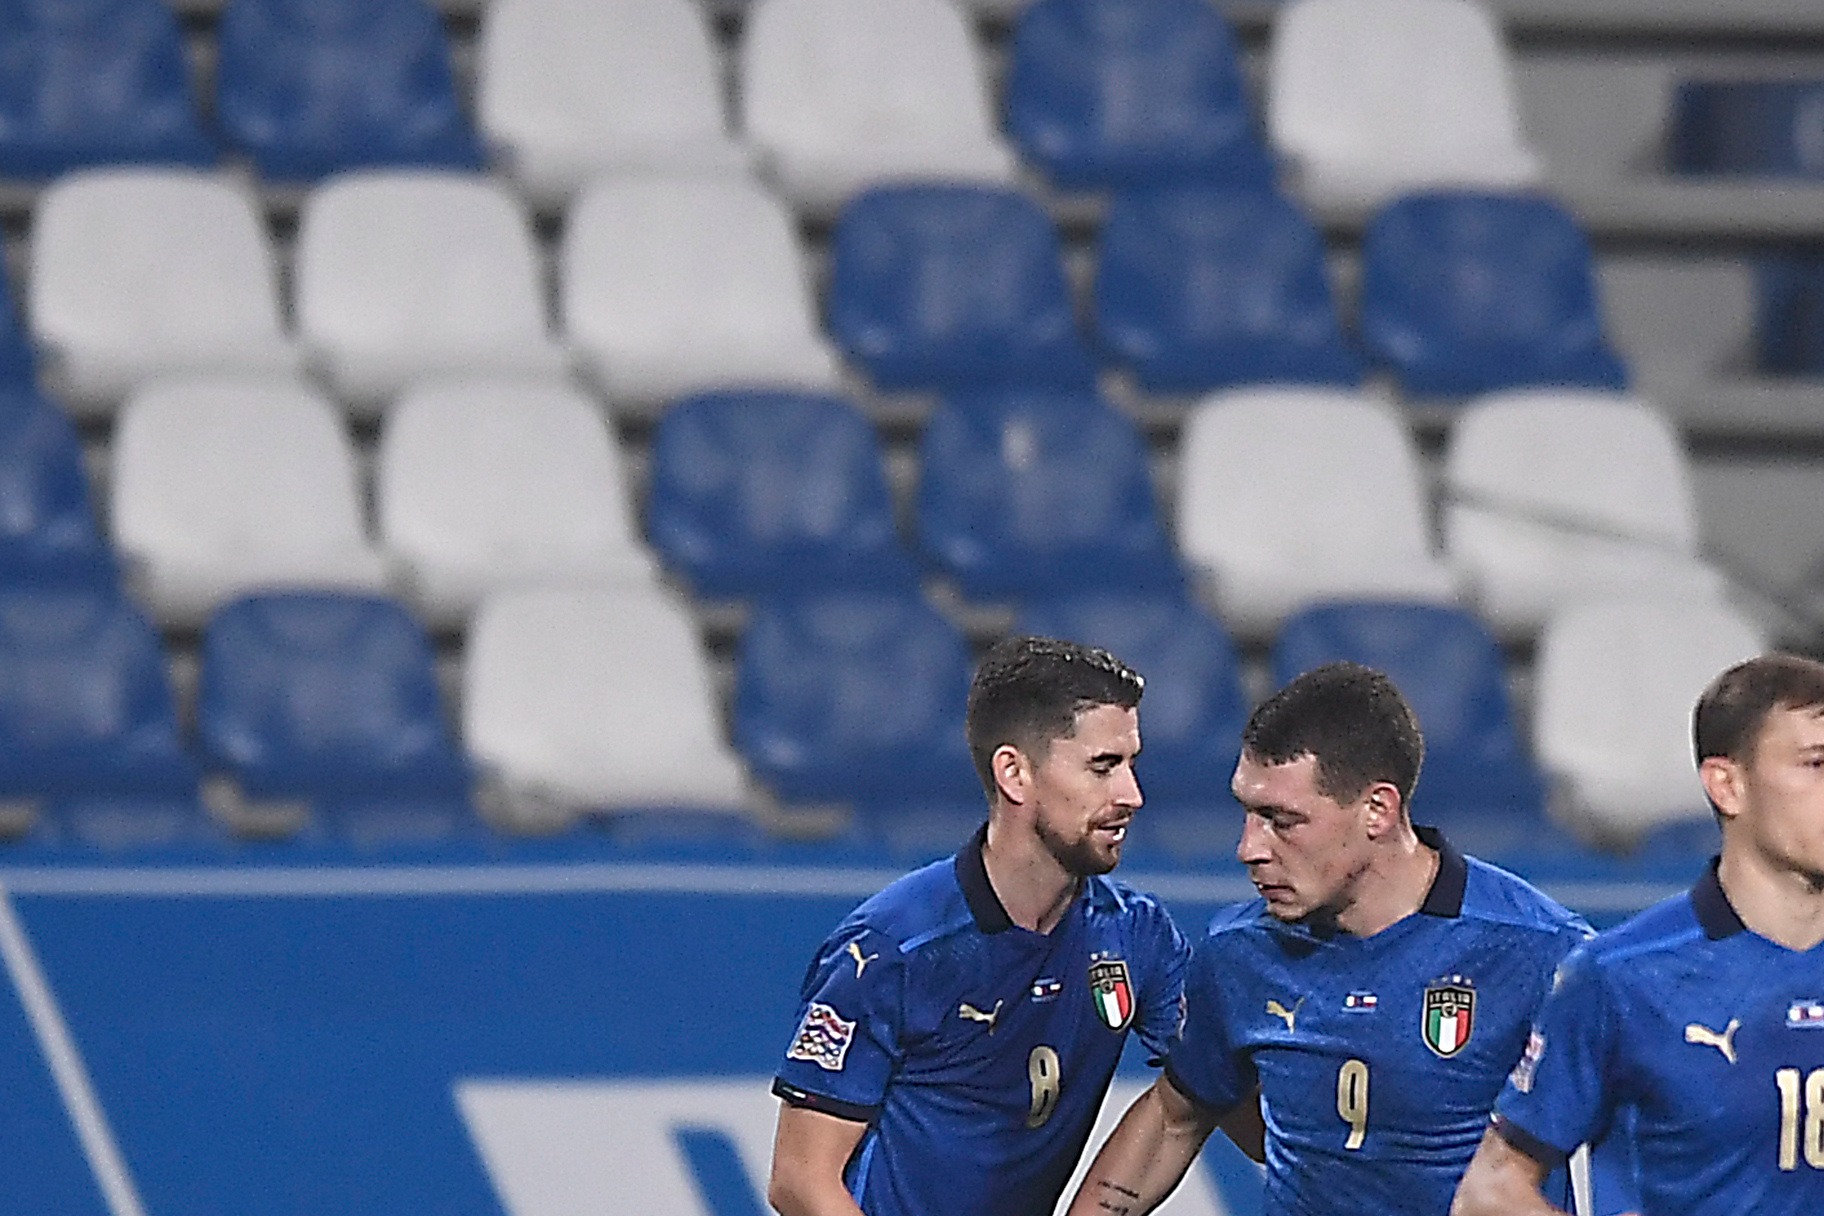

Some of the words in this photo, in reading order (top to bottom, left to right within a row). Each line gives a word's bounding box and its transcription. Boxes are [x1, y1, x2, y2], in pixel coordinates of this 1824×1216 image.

[1428, 991, 1471, 1003] ITALIA
[1028, 1045, 1061, 1129] 8
[1335, 1059, 1370, 1150] 9
